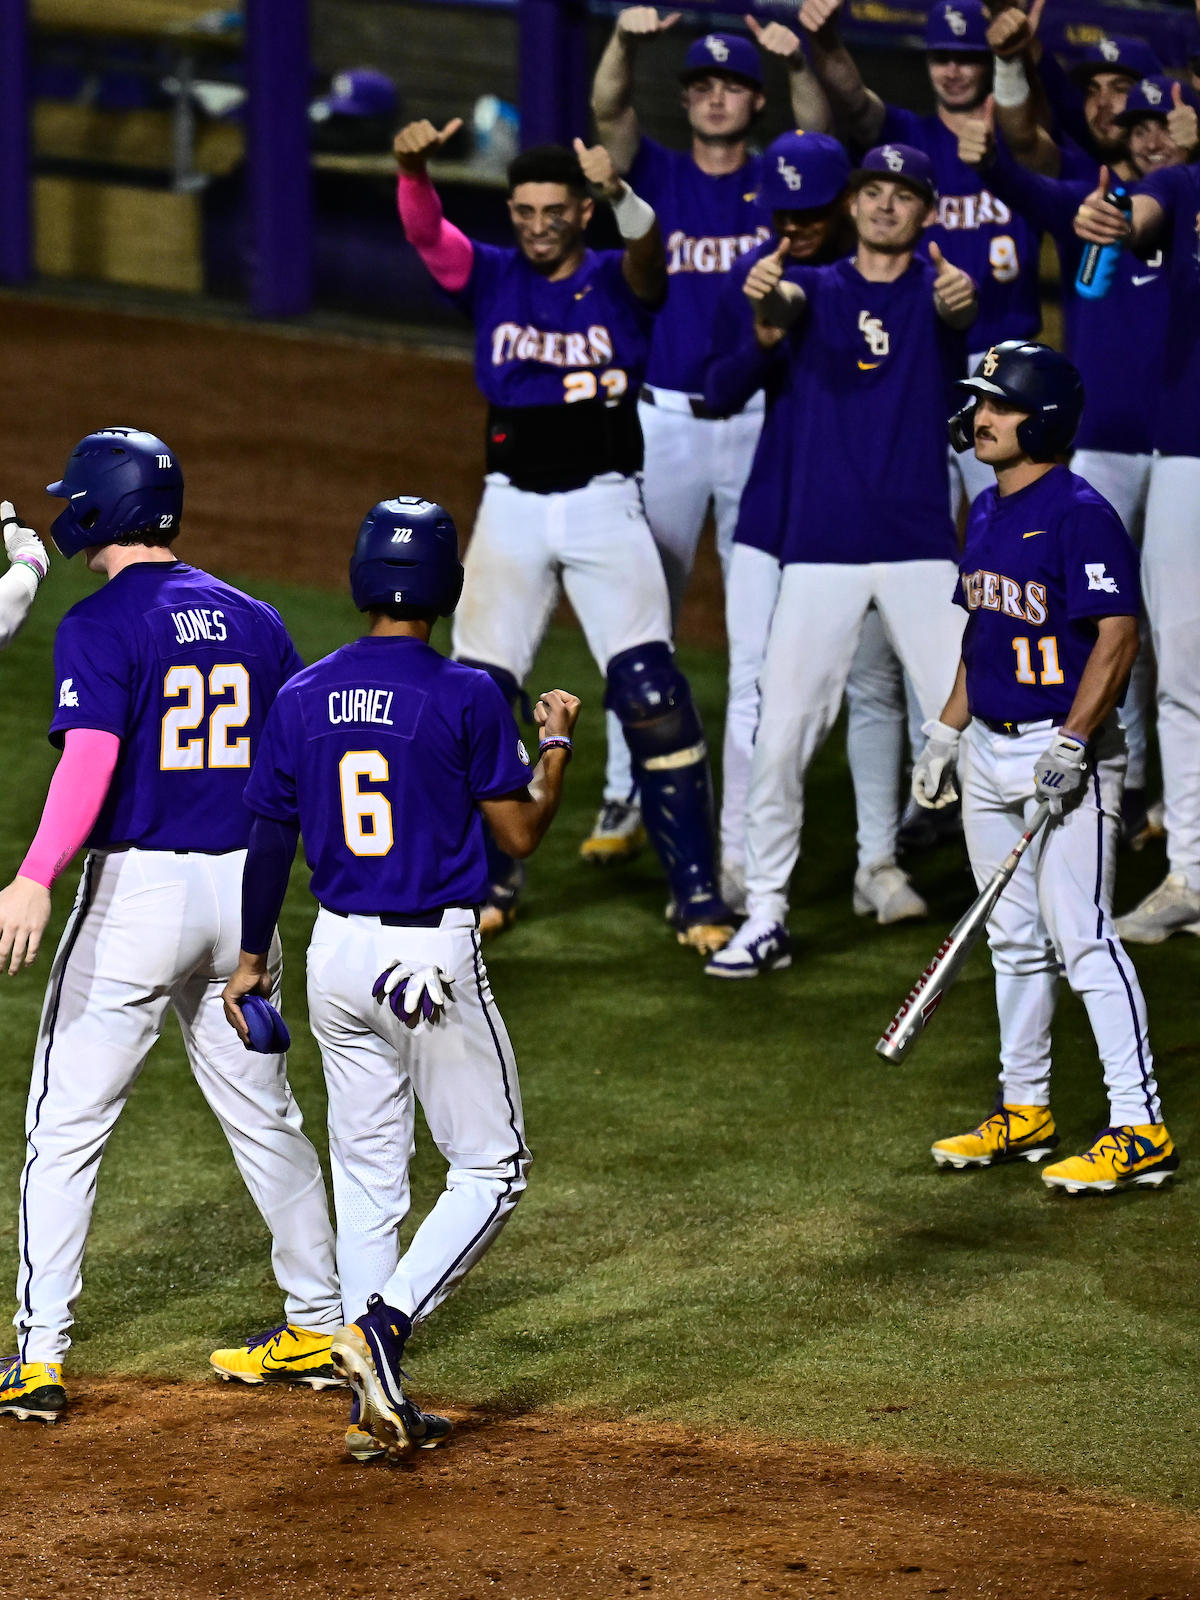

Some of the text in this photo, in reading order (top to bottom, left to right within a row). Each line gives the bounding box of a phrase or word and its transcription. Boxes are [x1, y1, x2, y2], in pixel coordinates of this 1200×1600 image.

[989, 235, 1020, 283] 9
[159, 514, 174, 529] 22
[394, 591, 403, 604] 6
[170, 609, 228, 645] JONES
[1012, 636, 1064, 685] 11
[160, 662, 251, 771] 22
[327, 688, 395, 727] CURIEL
[338, 749, 395, 857] 6
[44, 1363, 59, 1383] LSU
